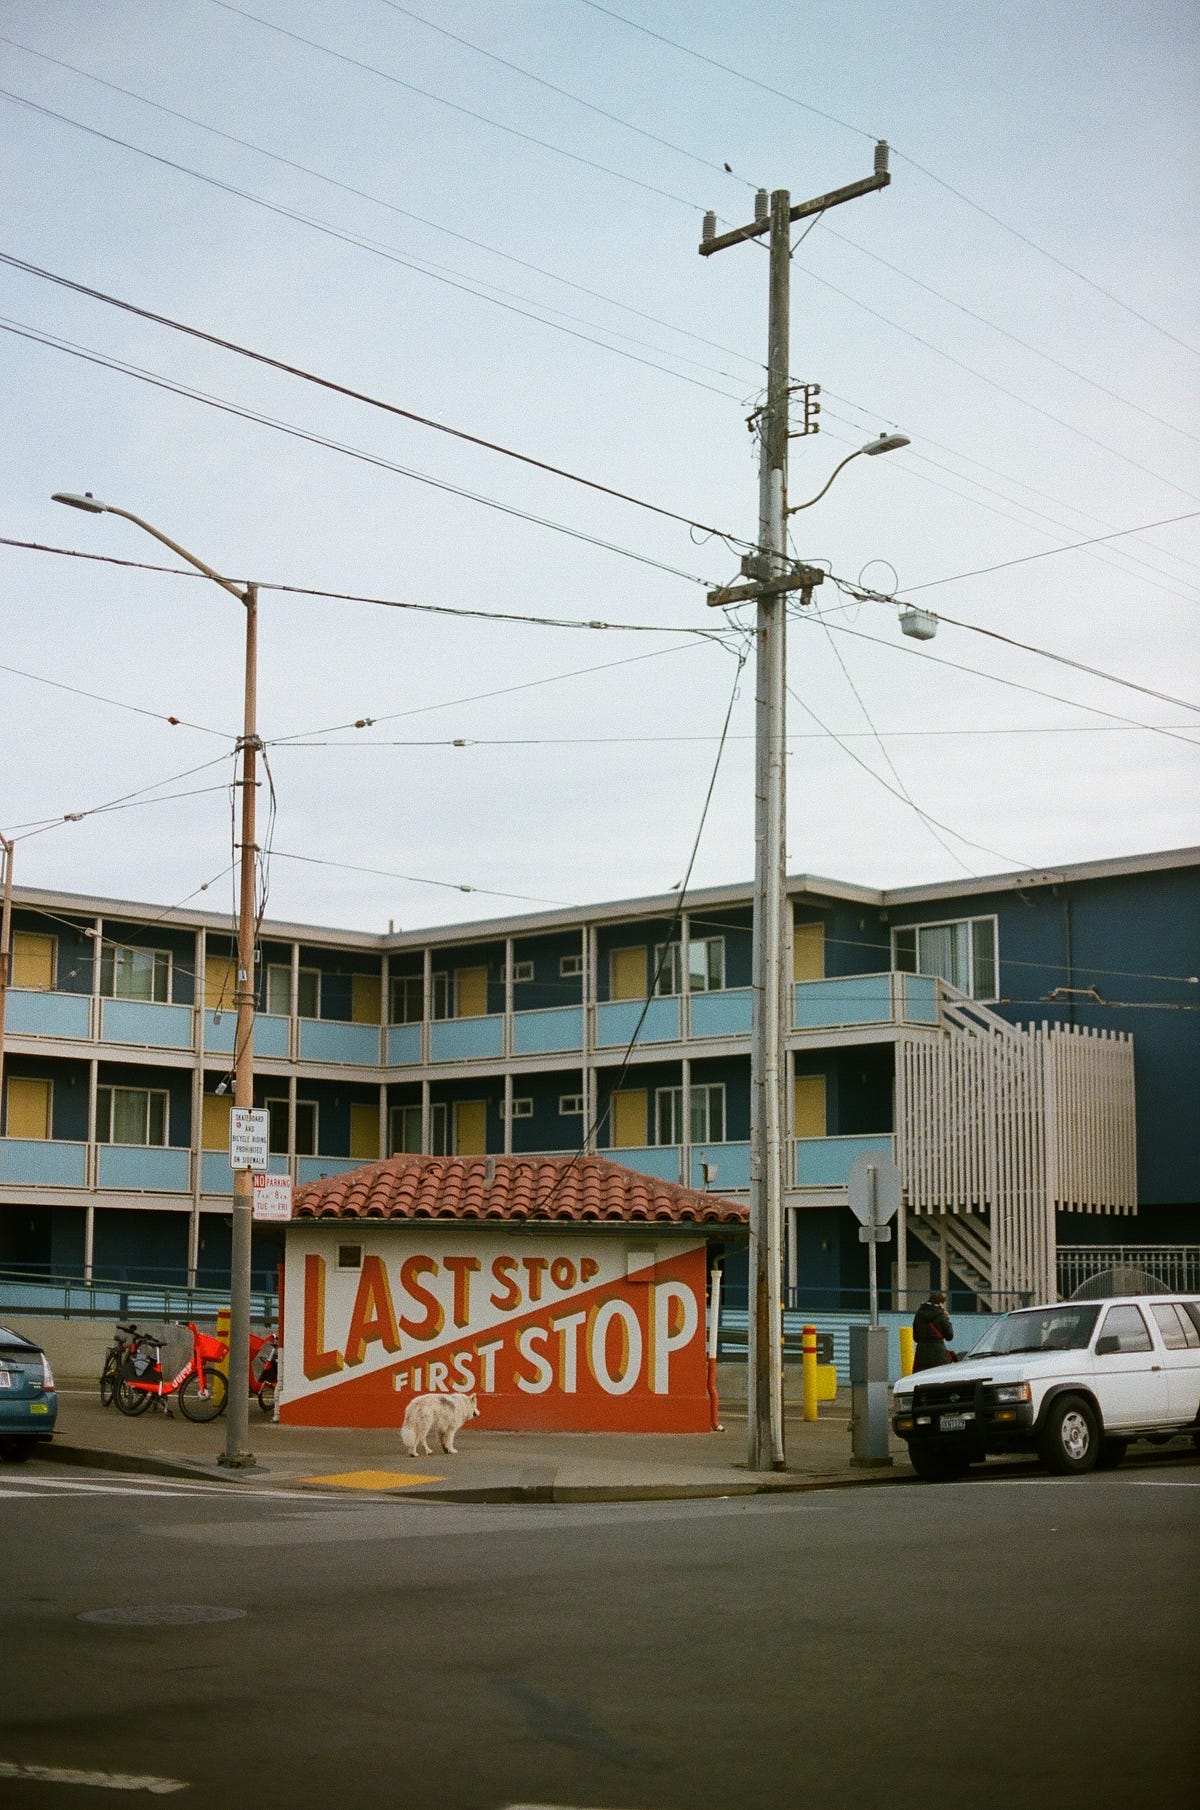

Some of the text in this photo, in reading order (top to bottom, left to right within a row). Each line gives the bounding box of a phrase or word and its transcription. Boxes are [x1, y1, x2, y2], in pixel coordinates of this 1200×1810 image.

[244, 1125, 255, 1133] AND
[232, 1135, 267, 1144] BICYCLE RIDING
[235, 1145, 263, 1154] PROHIBITED
[233, 1155, 265, 1165] ON SIDEWALK
[254, 1175, 290, 1188] NO PARKING
[257, 1202, 268, 1210] TUE
[277, 1202, 288, 1211] FRI
[304, 1254, 600, 1381] LAST STOP
[392, 1277, 698, 1396] FIRST STOP
[171, 1361, 193, 1389] JUMP
